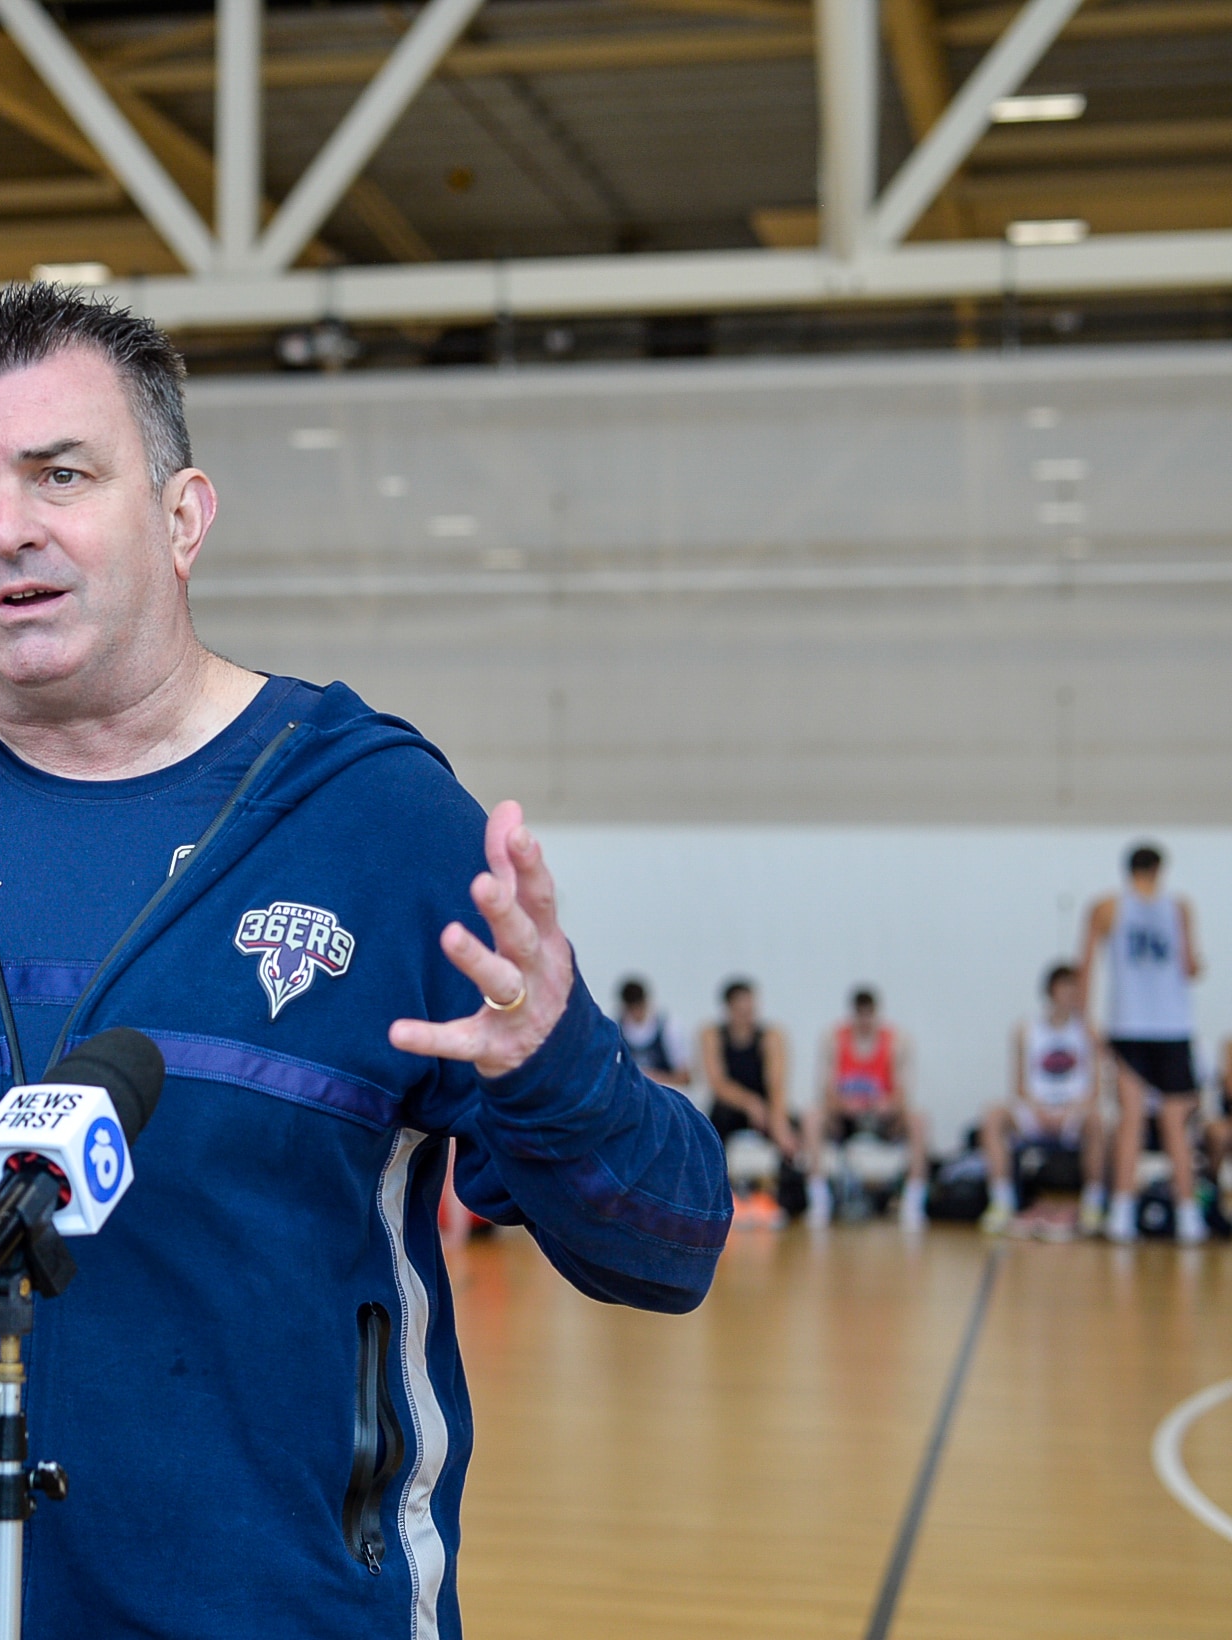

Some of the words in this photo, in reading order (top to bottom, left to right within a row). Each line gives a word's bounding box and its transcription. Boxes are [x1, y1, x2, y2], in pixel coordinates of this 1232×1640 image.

[273, 905, 332, 926] ADELAIDE
[241, 914, 351, 967] 36ERS
[9, 1092, 83, 1110] NEWS
